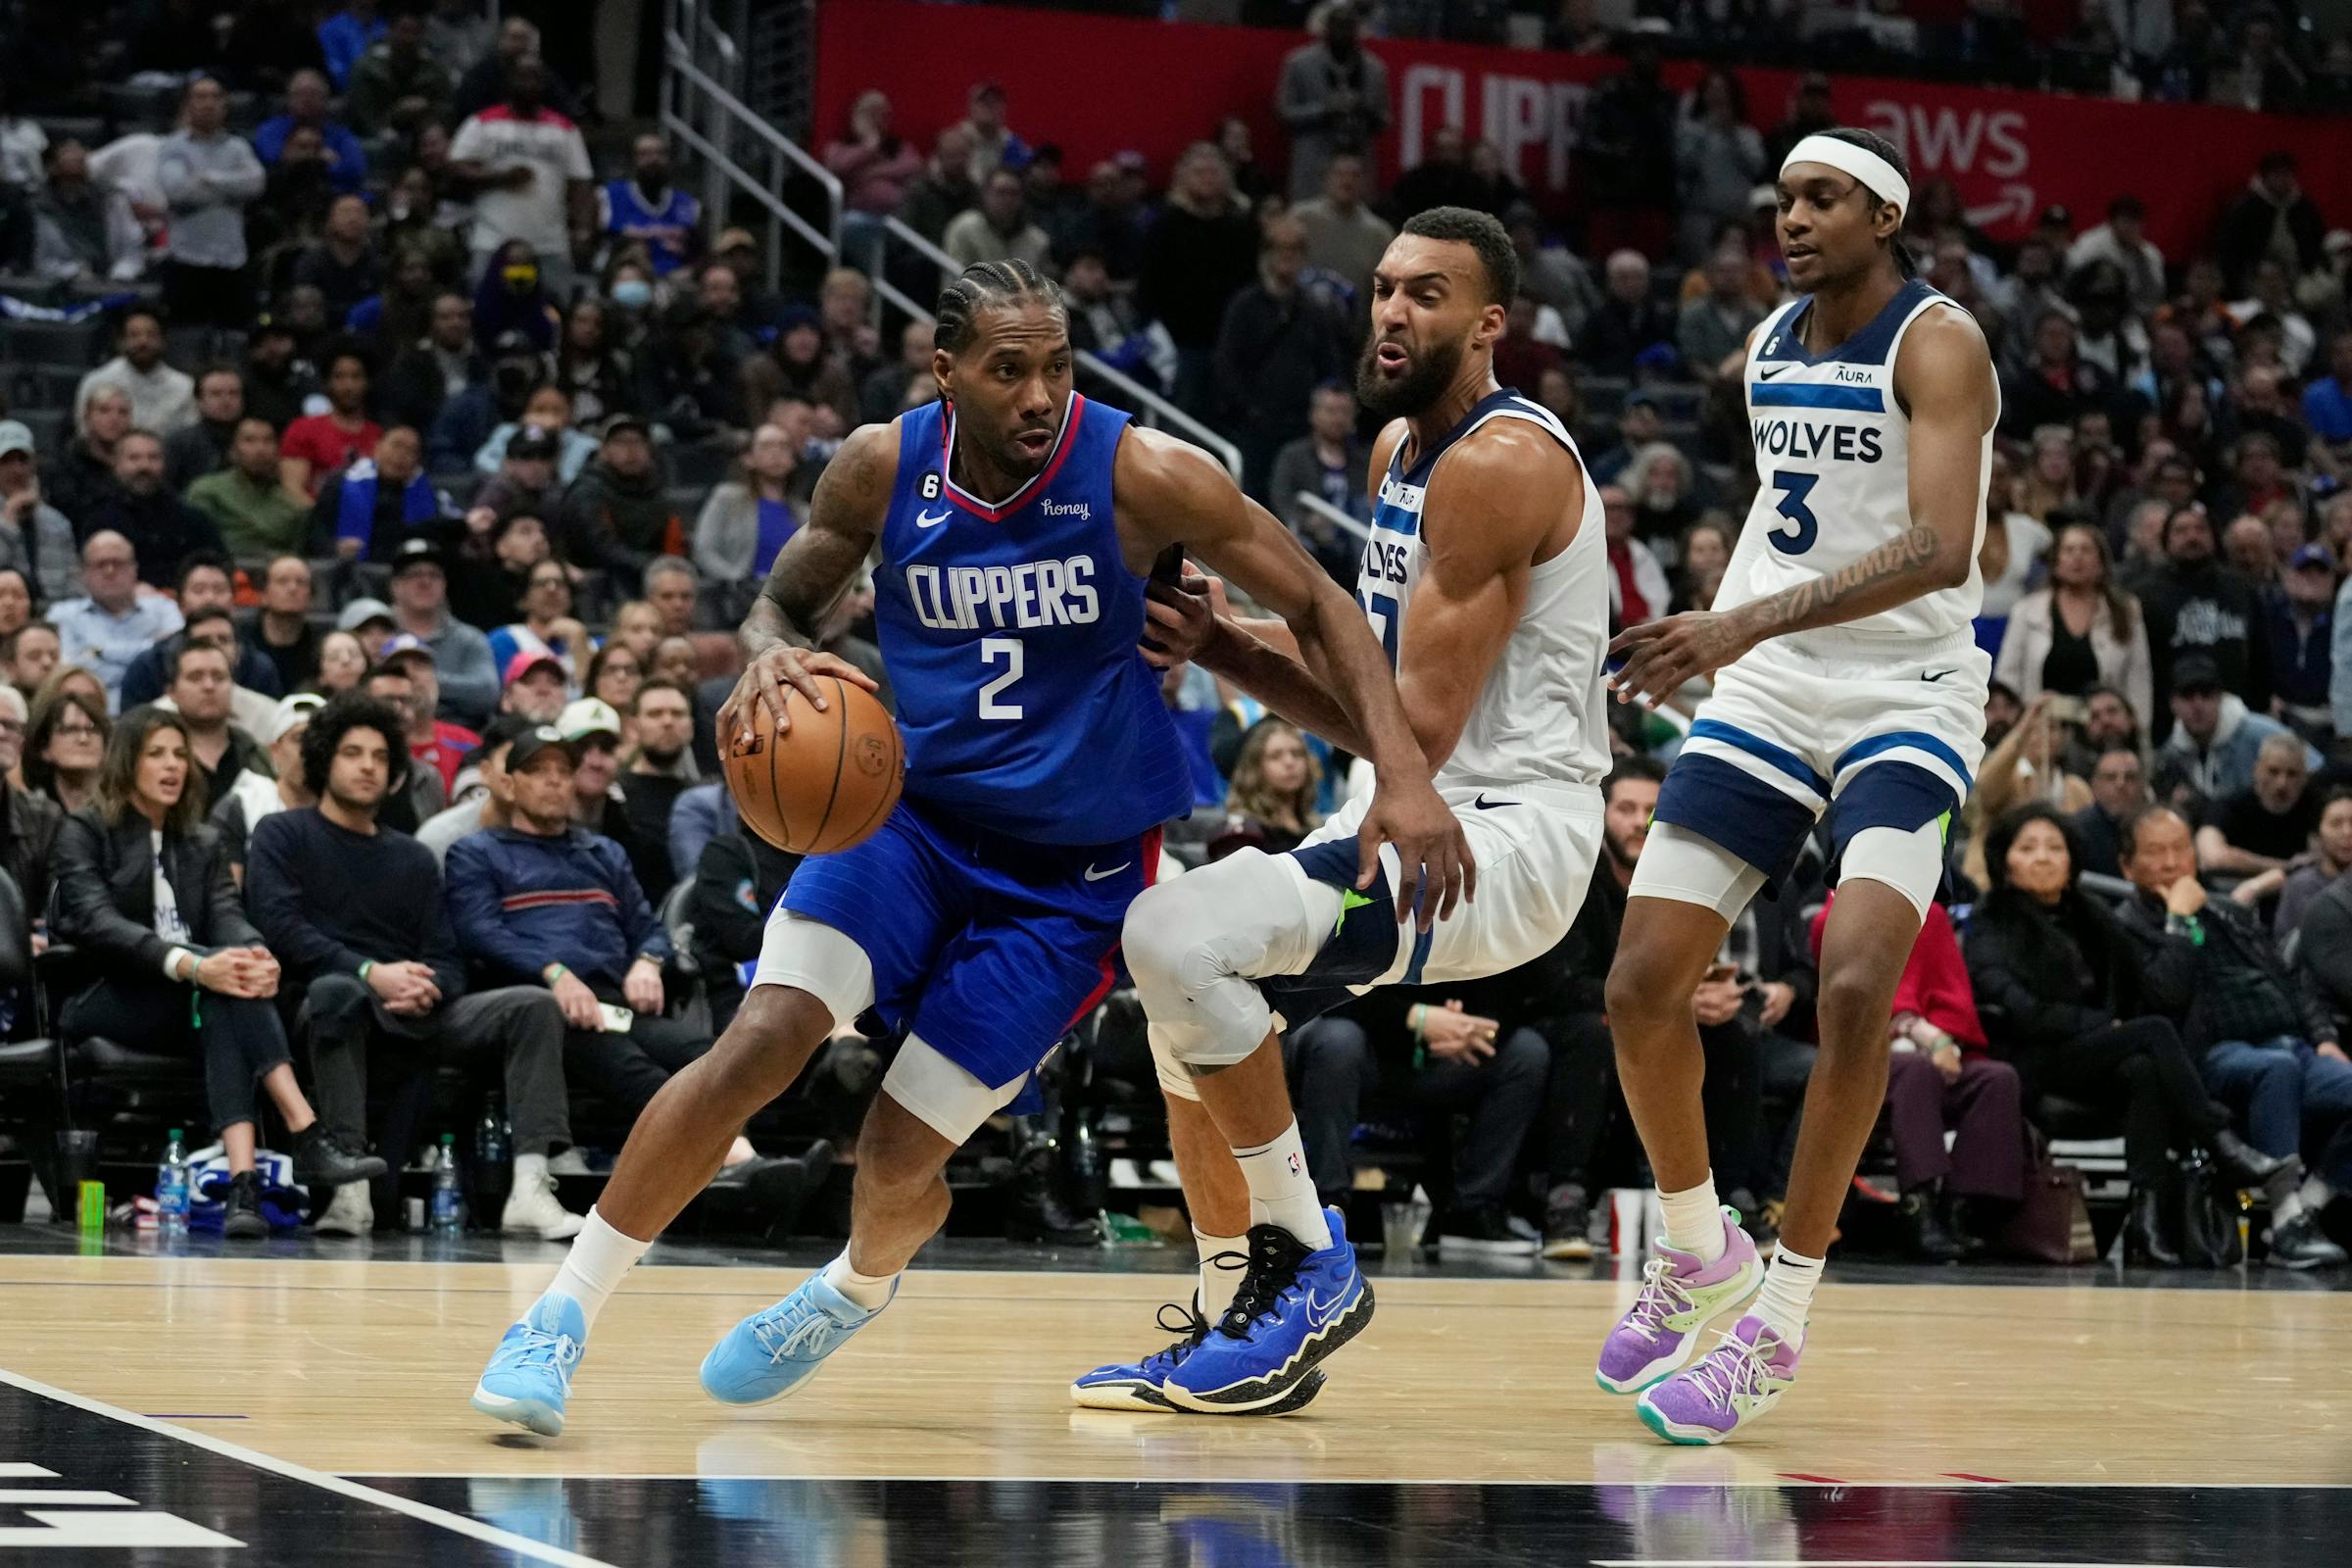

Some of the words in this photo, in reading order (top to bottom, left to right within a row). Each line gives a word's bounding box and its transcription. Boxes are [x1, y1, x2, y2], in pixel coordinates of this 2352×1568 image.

[1400, 63, 1592, 192] CLIPP
[1865, 100, 2030, 178] aws
[1765, 335, 1781, 356] 6
[1754, 419, 1883, 463] WOLVES
[922, 473, 939, 498] 6
[1041, 499, 1091, 520] honey
[1767, 469, 1819, 556] 3
[906, 555, 1101, 629] CLIPPERS
[1360, 541, 1407, 584] LVES
[1356, 588, 1399, 678] 7
[979, 637, 1024, 720] 2
